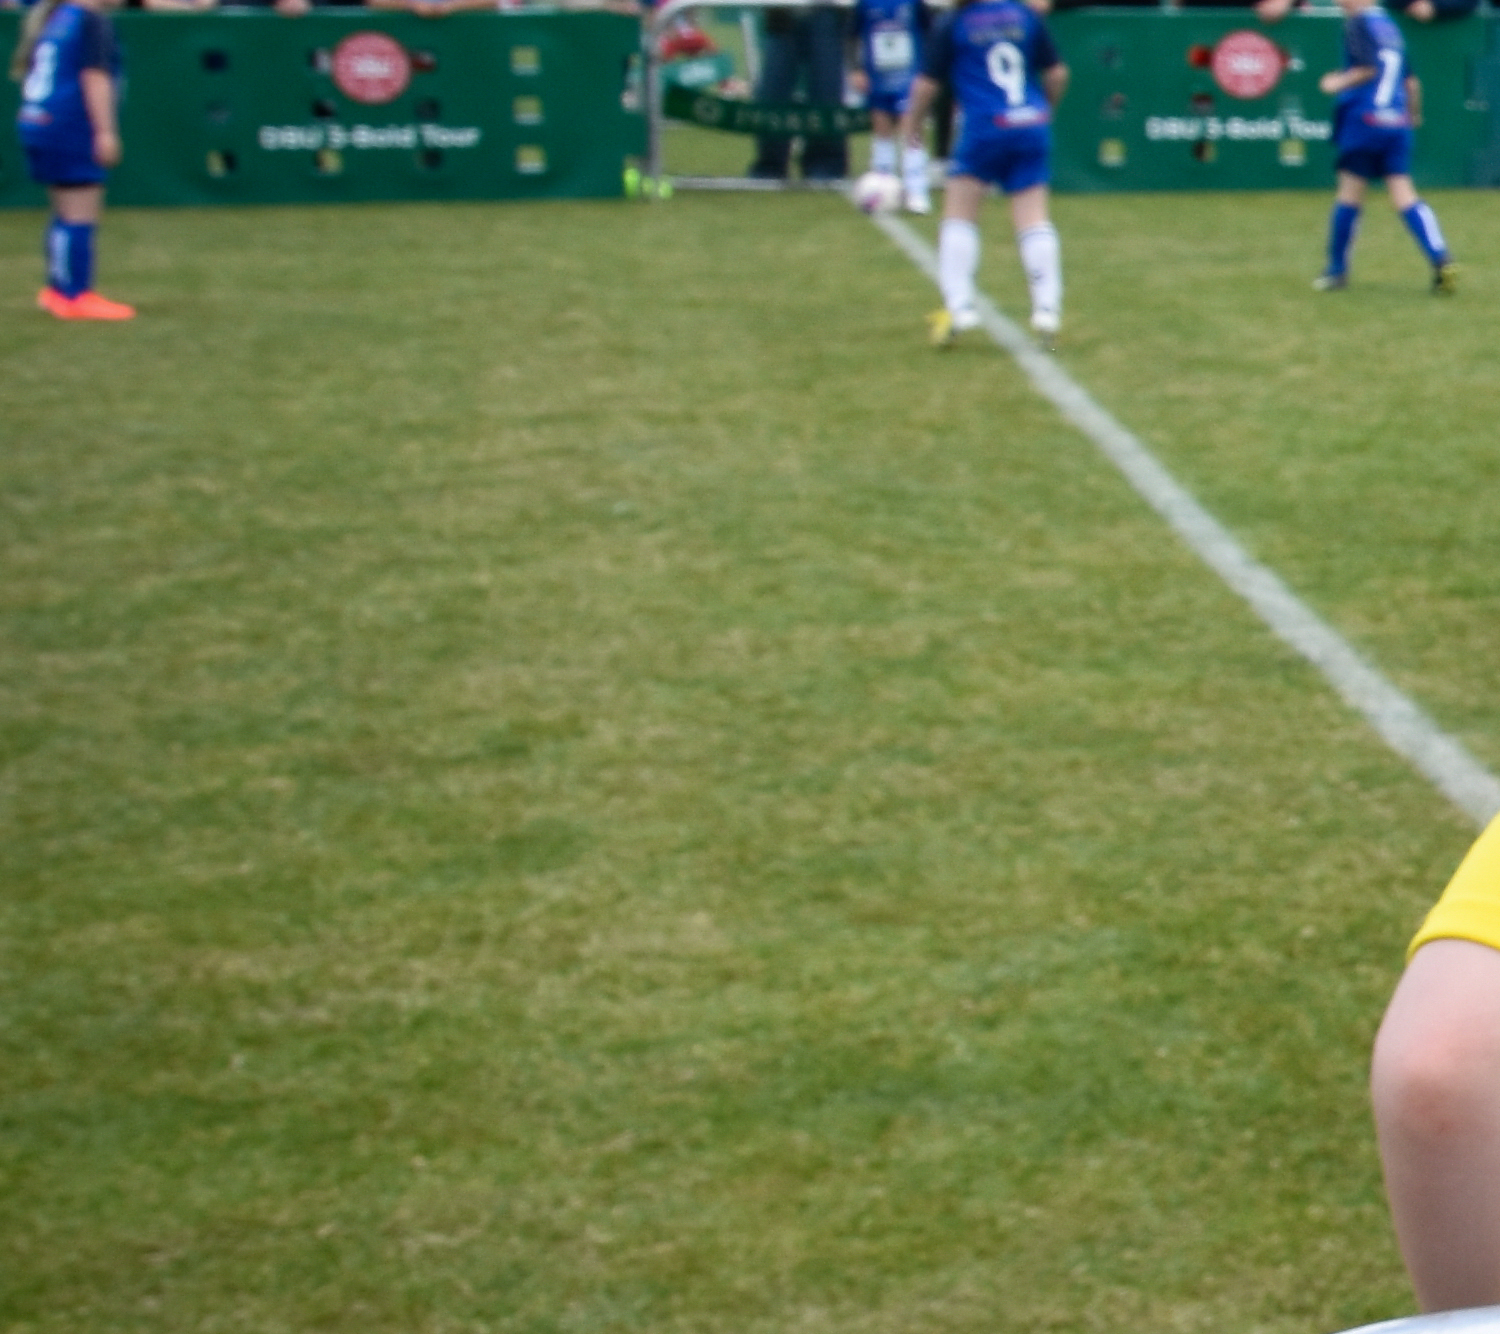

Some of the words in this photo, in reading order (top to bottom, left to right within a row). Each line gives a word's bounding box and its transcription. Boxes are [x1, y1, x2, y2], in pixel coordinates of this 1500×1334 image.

[986, 41, 1025, 106] 9
[258, 124, 324, 151] DBU
[418, 122, 482, 149] Tour
[1145, 116, 1202, 141] DBU
